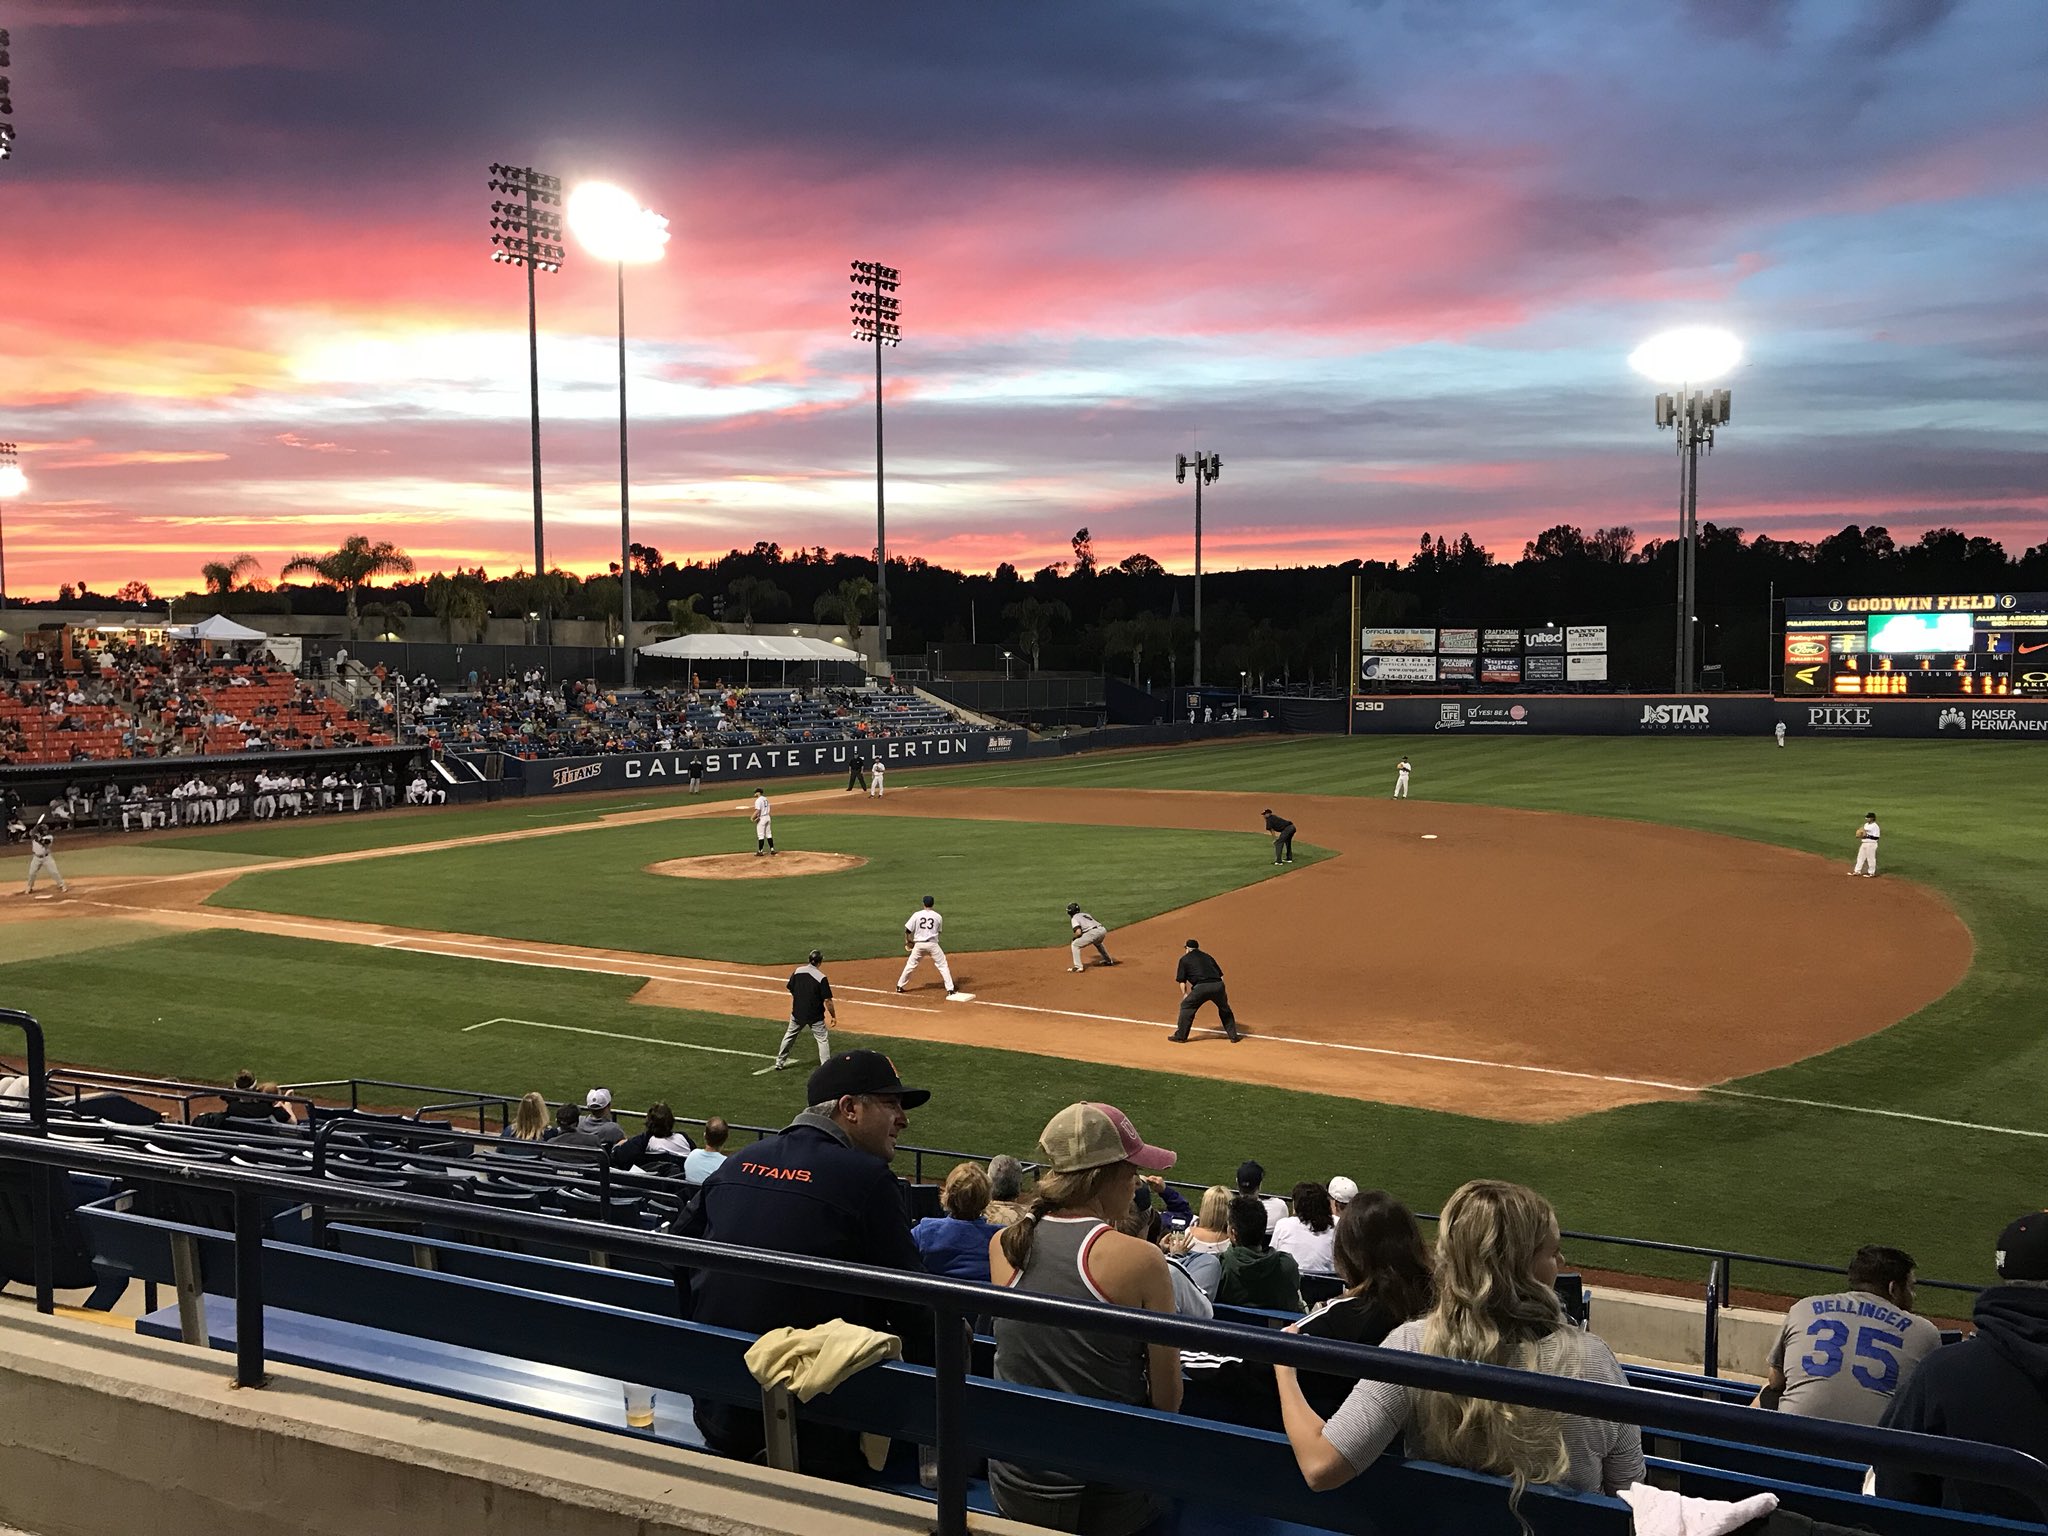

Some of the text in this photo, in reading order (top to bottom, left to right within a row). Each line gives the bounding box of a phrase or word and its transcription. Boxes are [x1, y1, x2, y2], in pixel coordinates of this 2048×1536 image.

[1847, 595, 1996, 612] GOODWIN FIELD
[1523, 626, 1563, 647] United
[1986, 633, 2001, 652] F
[1793, 642, 1820, 655] Ford
[1484, 658, 1515, 666] Super
[1356, 702, 1384, 711] 330
[1972, 709, 2016, 720] KAISER
[1808, 708, 1871, 725] PIKE
[626, 757, 689, 778] CAL
[706, 750, 800, 772] STATE
[919, 917, 935, 930] 23
[741, 1162, 812, 1182] TITANS
[1812, 1299, 1913, 1332] BELLINGER
[1801, 1319, 1904, 1393] 35
